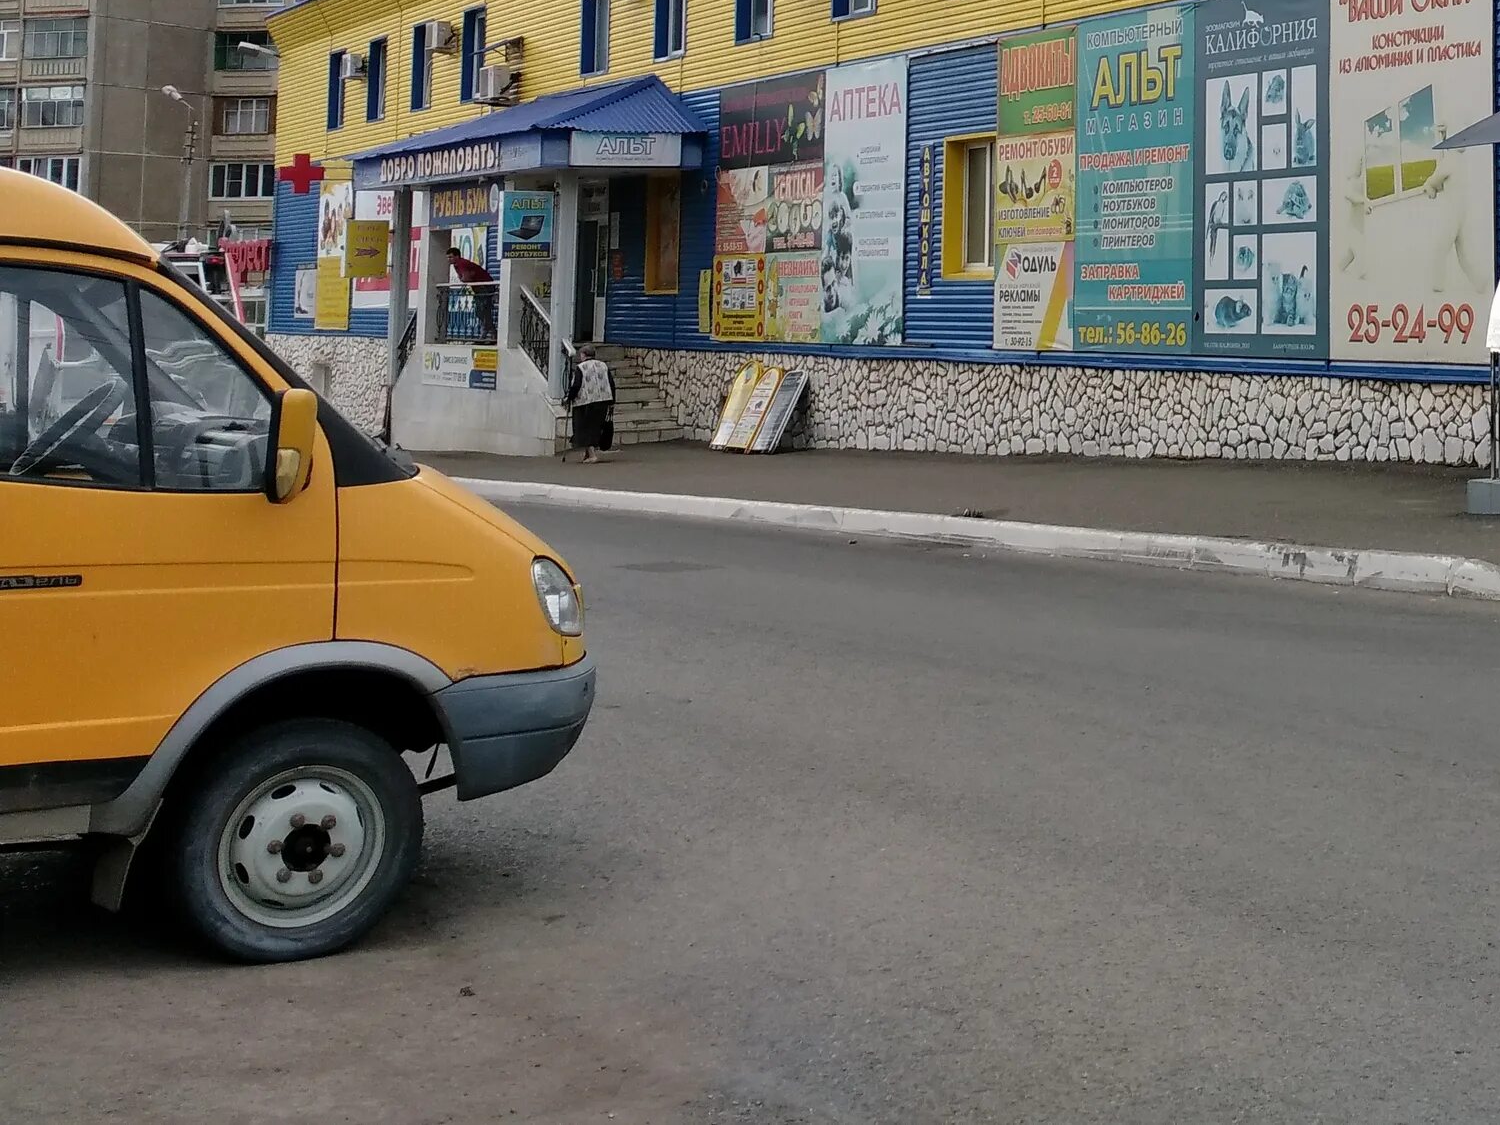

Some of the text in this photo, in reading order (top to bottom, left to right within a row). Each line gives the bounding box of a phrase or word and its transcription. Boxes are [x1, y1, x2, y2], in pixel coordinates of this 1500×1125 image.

[1087, 17, 1184, 50] КОМПЬЮТЕРНЫЙ
[1205, 20, 1240, 32] ЗООМАГАЗИН
[1205, 17, 1318, 55] КАЛИФОРНИЯ
[1372, 25, 1445, 50] КОНСТРУКЦИИ
[1001, 37, 1075, 102] АДВОКАТЫ
[1339, 40, 1482, 74] ИЗ АЛЮМИНИЯ И ПЛАСТИКА
[1089, 44, 1183, 111] АЛЬТ
[830, 82, 902, 122] АПТЕКА
[1086, 107, 1183, 135] МАГАЗИН
[596, 137, 656, 155] АЛЬТ
[721, 115, 787, 159] EMILLY
[999, 136, 1074, 161] РЕМОНТ ОБУВИ
[380, 142, 500, 182] ДОБРО ПОЖАЛОВАТЬ!
[1079, 144, 1190, 172] ПРОДАЖА И РЕМОНТ
[1101, 177, 1174, 195] КОМПЬЮТЕРОВ
[433, 187, 488, 218] РУБЛЬ БУМ
[511, 197, 548, 211] АЛЬТ
[998, 206, 1051, 221] ИЗГОТОВЛЕНИЕ
[1101, 197, 1157, 213] НОУТБУКОВ
[920, 147, 931, 285] АВТОШКОЛА
[1101, 215, 1161, 231] МОНИТОРОВ
[998, 224, 1026, 239] КЛЮЧЕЙ
[1101, 233, 1156, 249] ПРИНТЕРОВ
[504, 250, 548, 258] НОУТБУКОВ
[511, 243, 542, 251] РЕМОНТ
[1081, 263, 1140, 280] ЗАПРАВКА
[1108, 280, 1186, 303] КАРТРИДЖЕЙ
[1116, 322, 1187, 346] 56-86-26
[1347, 303, 1475, 344] 25-24-99
